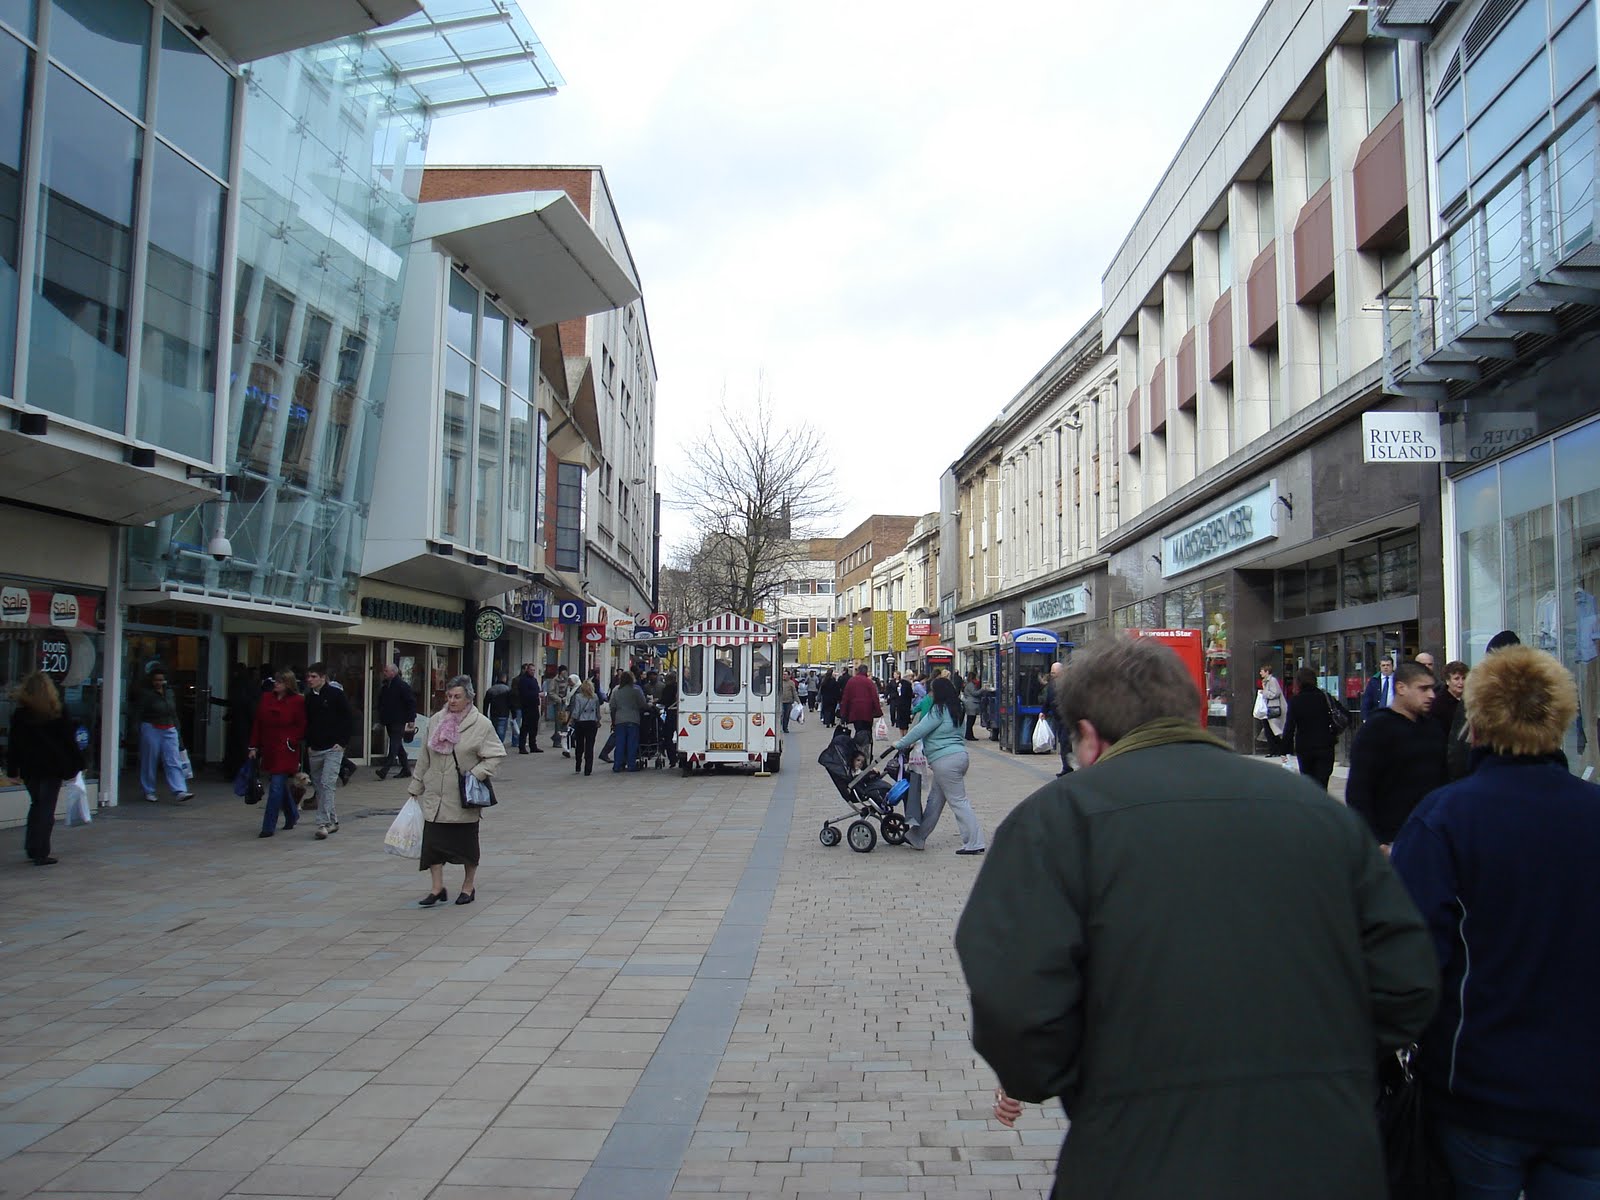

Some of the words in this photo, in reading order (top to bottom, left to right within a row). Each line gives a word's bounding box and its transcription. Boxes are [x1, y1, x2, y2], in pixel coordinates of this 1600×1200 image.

[1370, 429, 1424, 444] RIVER
[1370, 444, 1436, 459] ISLAND
[2, 593, 28, 609] sale
[53, 599, 77, 614] sale
[561, 602, 581, 622] O2
[42, 640, 66, 653] boots
[41, 653, 68, 672] £20
